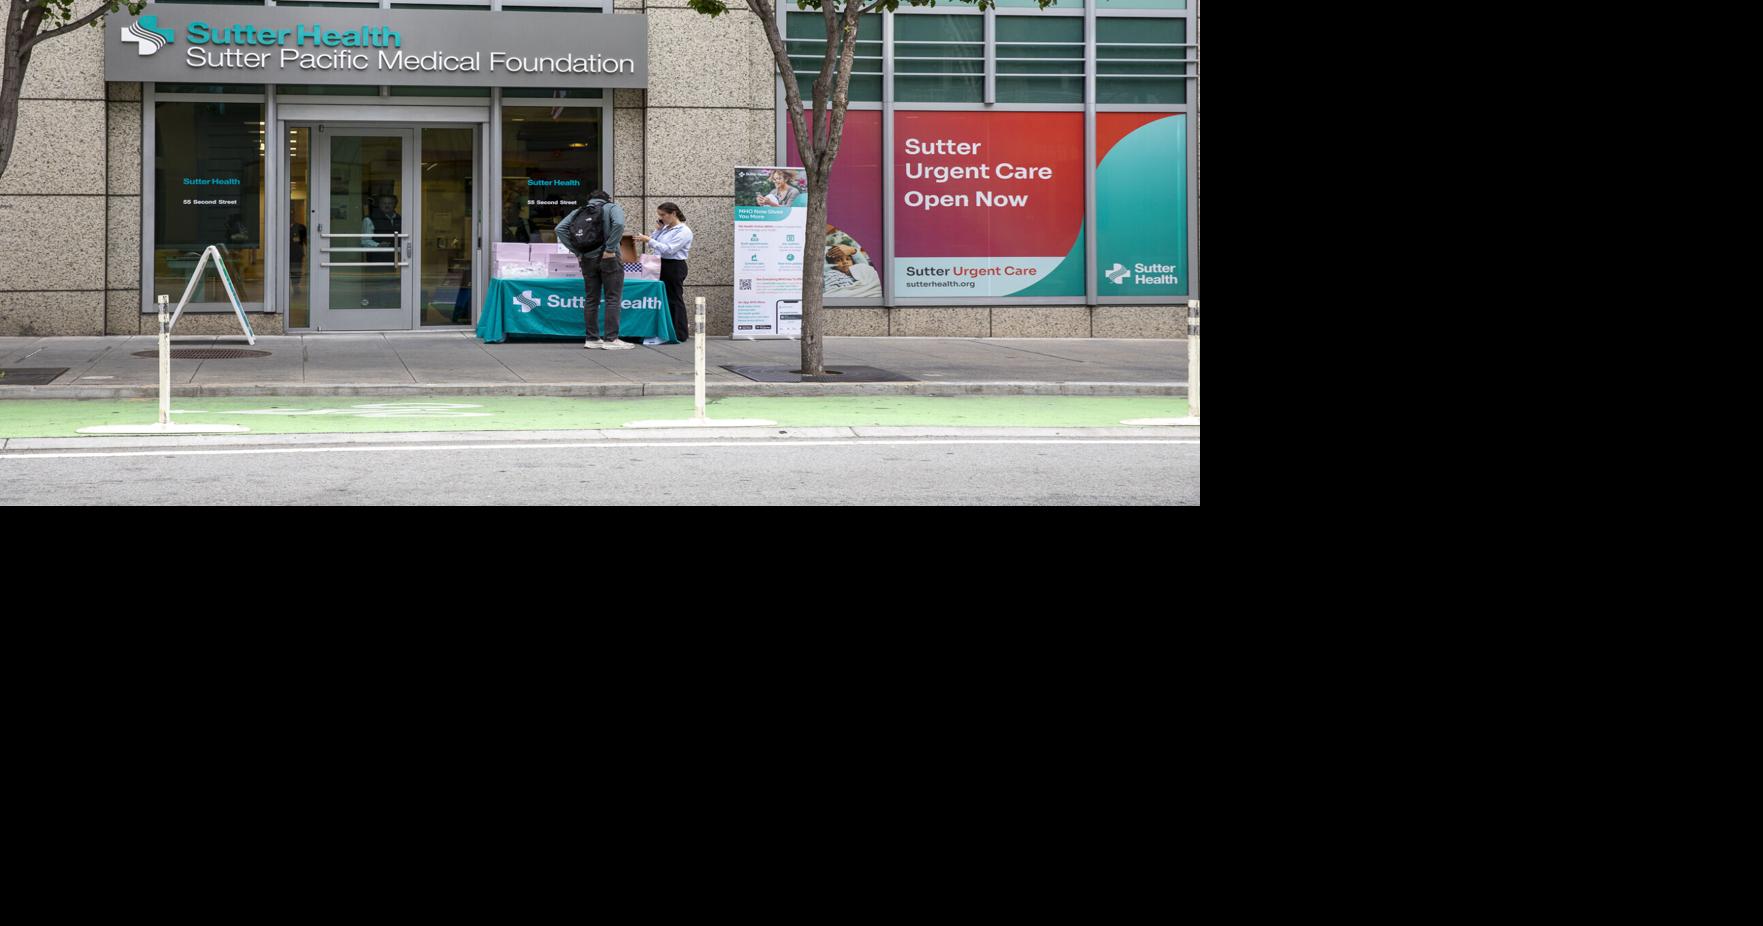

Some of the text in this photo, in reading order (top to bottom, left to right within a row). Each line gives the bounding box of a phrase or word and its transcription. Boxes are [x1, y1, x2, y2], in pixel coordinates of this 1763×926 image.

[186, 21, 401, 48] Sutter Health
[186, 46, 635, 74] Sutter Pacific Medical Foundation
[905, 137, 982, 156] Sutter
[905, 161, 1053, 183] Urgent Care
[183, 177, 240, 185] Sutter Health
[904, 190, 1029, 210] Open Now
[906, 265, 1037, 278] Sutter Urgent Care
[1134, 262, 1177, 273] Sutter
[905, 280, 976, 288] sutterhealth.org
[1135, 274, 1178, 285] Health
[547, 294, 662, 310] Sutt ealth
